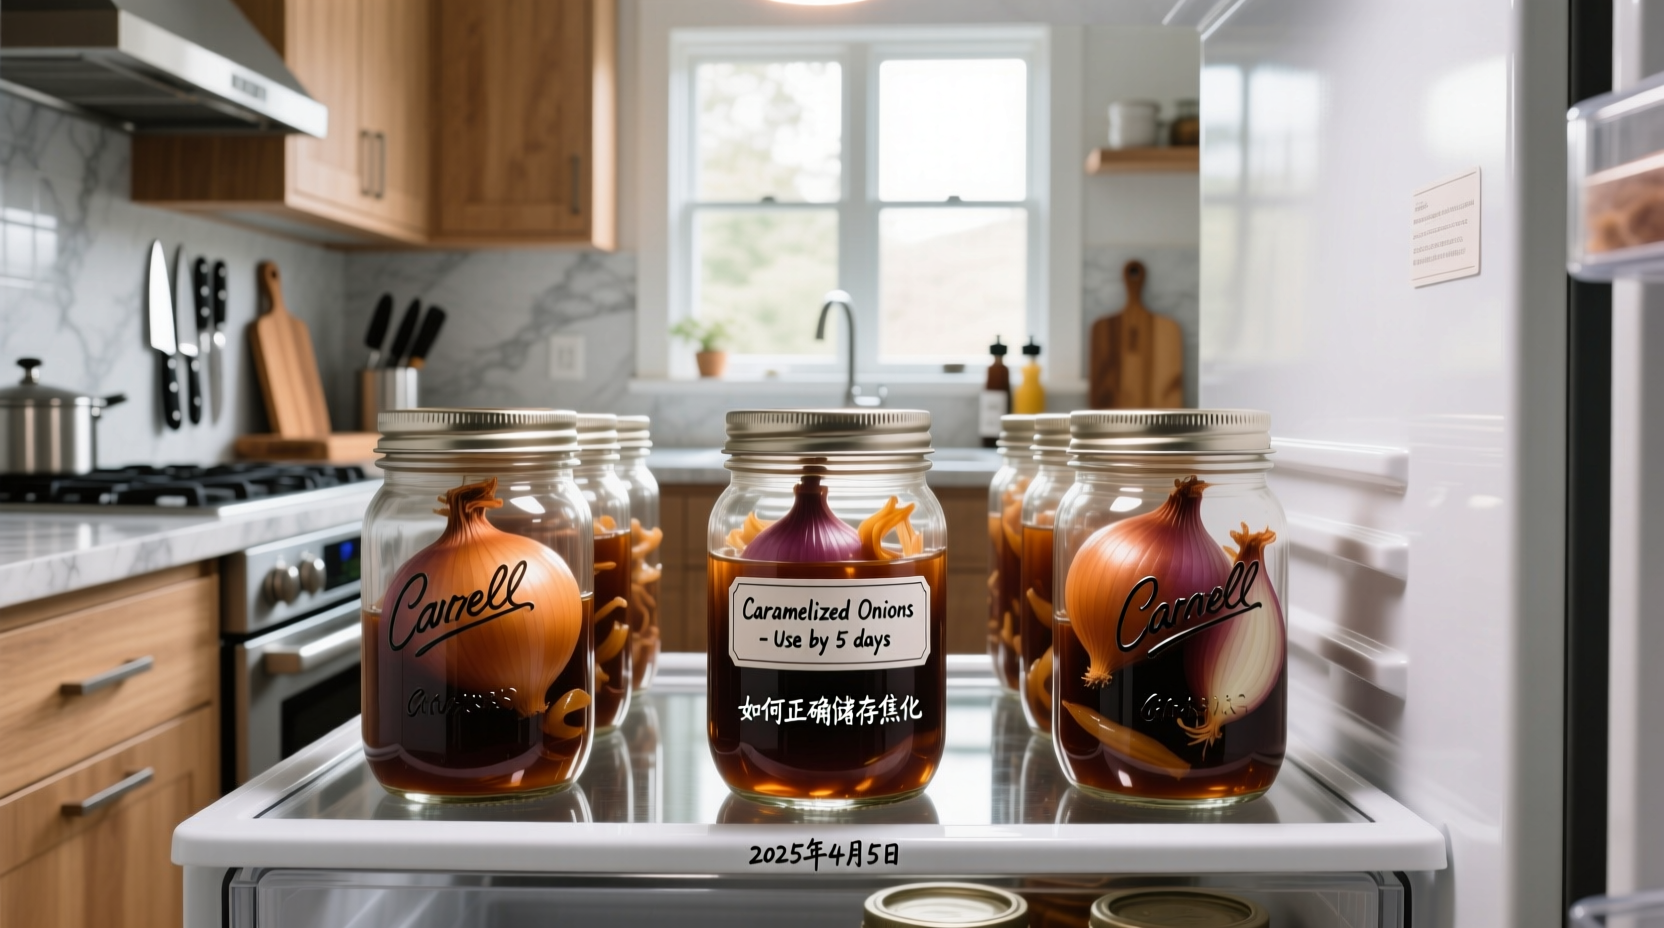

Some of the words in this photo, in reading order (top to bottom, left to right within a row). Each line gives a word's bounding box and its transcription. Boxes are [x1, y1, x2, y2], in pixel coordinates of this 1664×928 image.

[742, 597, 851, 621] Caramelized
[858, 598, 914, 621] Onions
[774, 630, 802, 648] Use
[809, 628, 829, 656] by
[836, 630, 848, 648] 5
[853, 628, 891, 656] days
[738, 693, 923, 726] 如何正确储存焦化
[749, 837, 899, 871] 2025年4月5日
